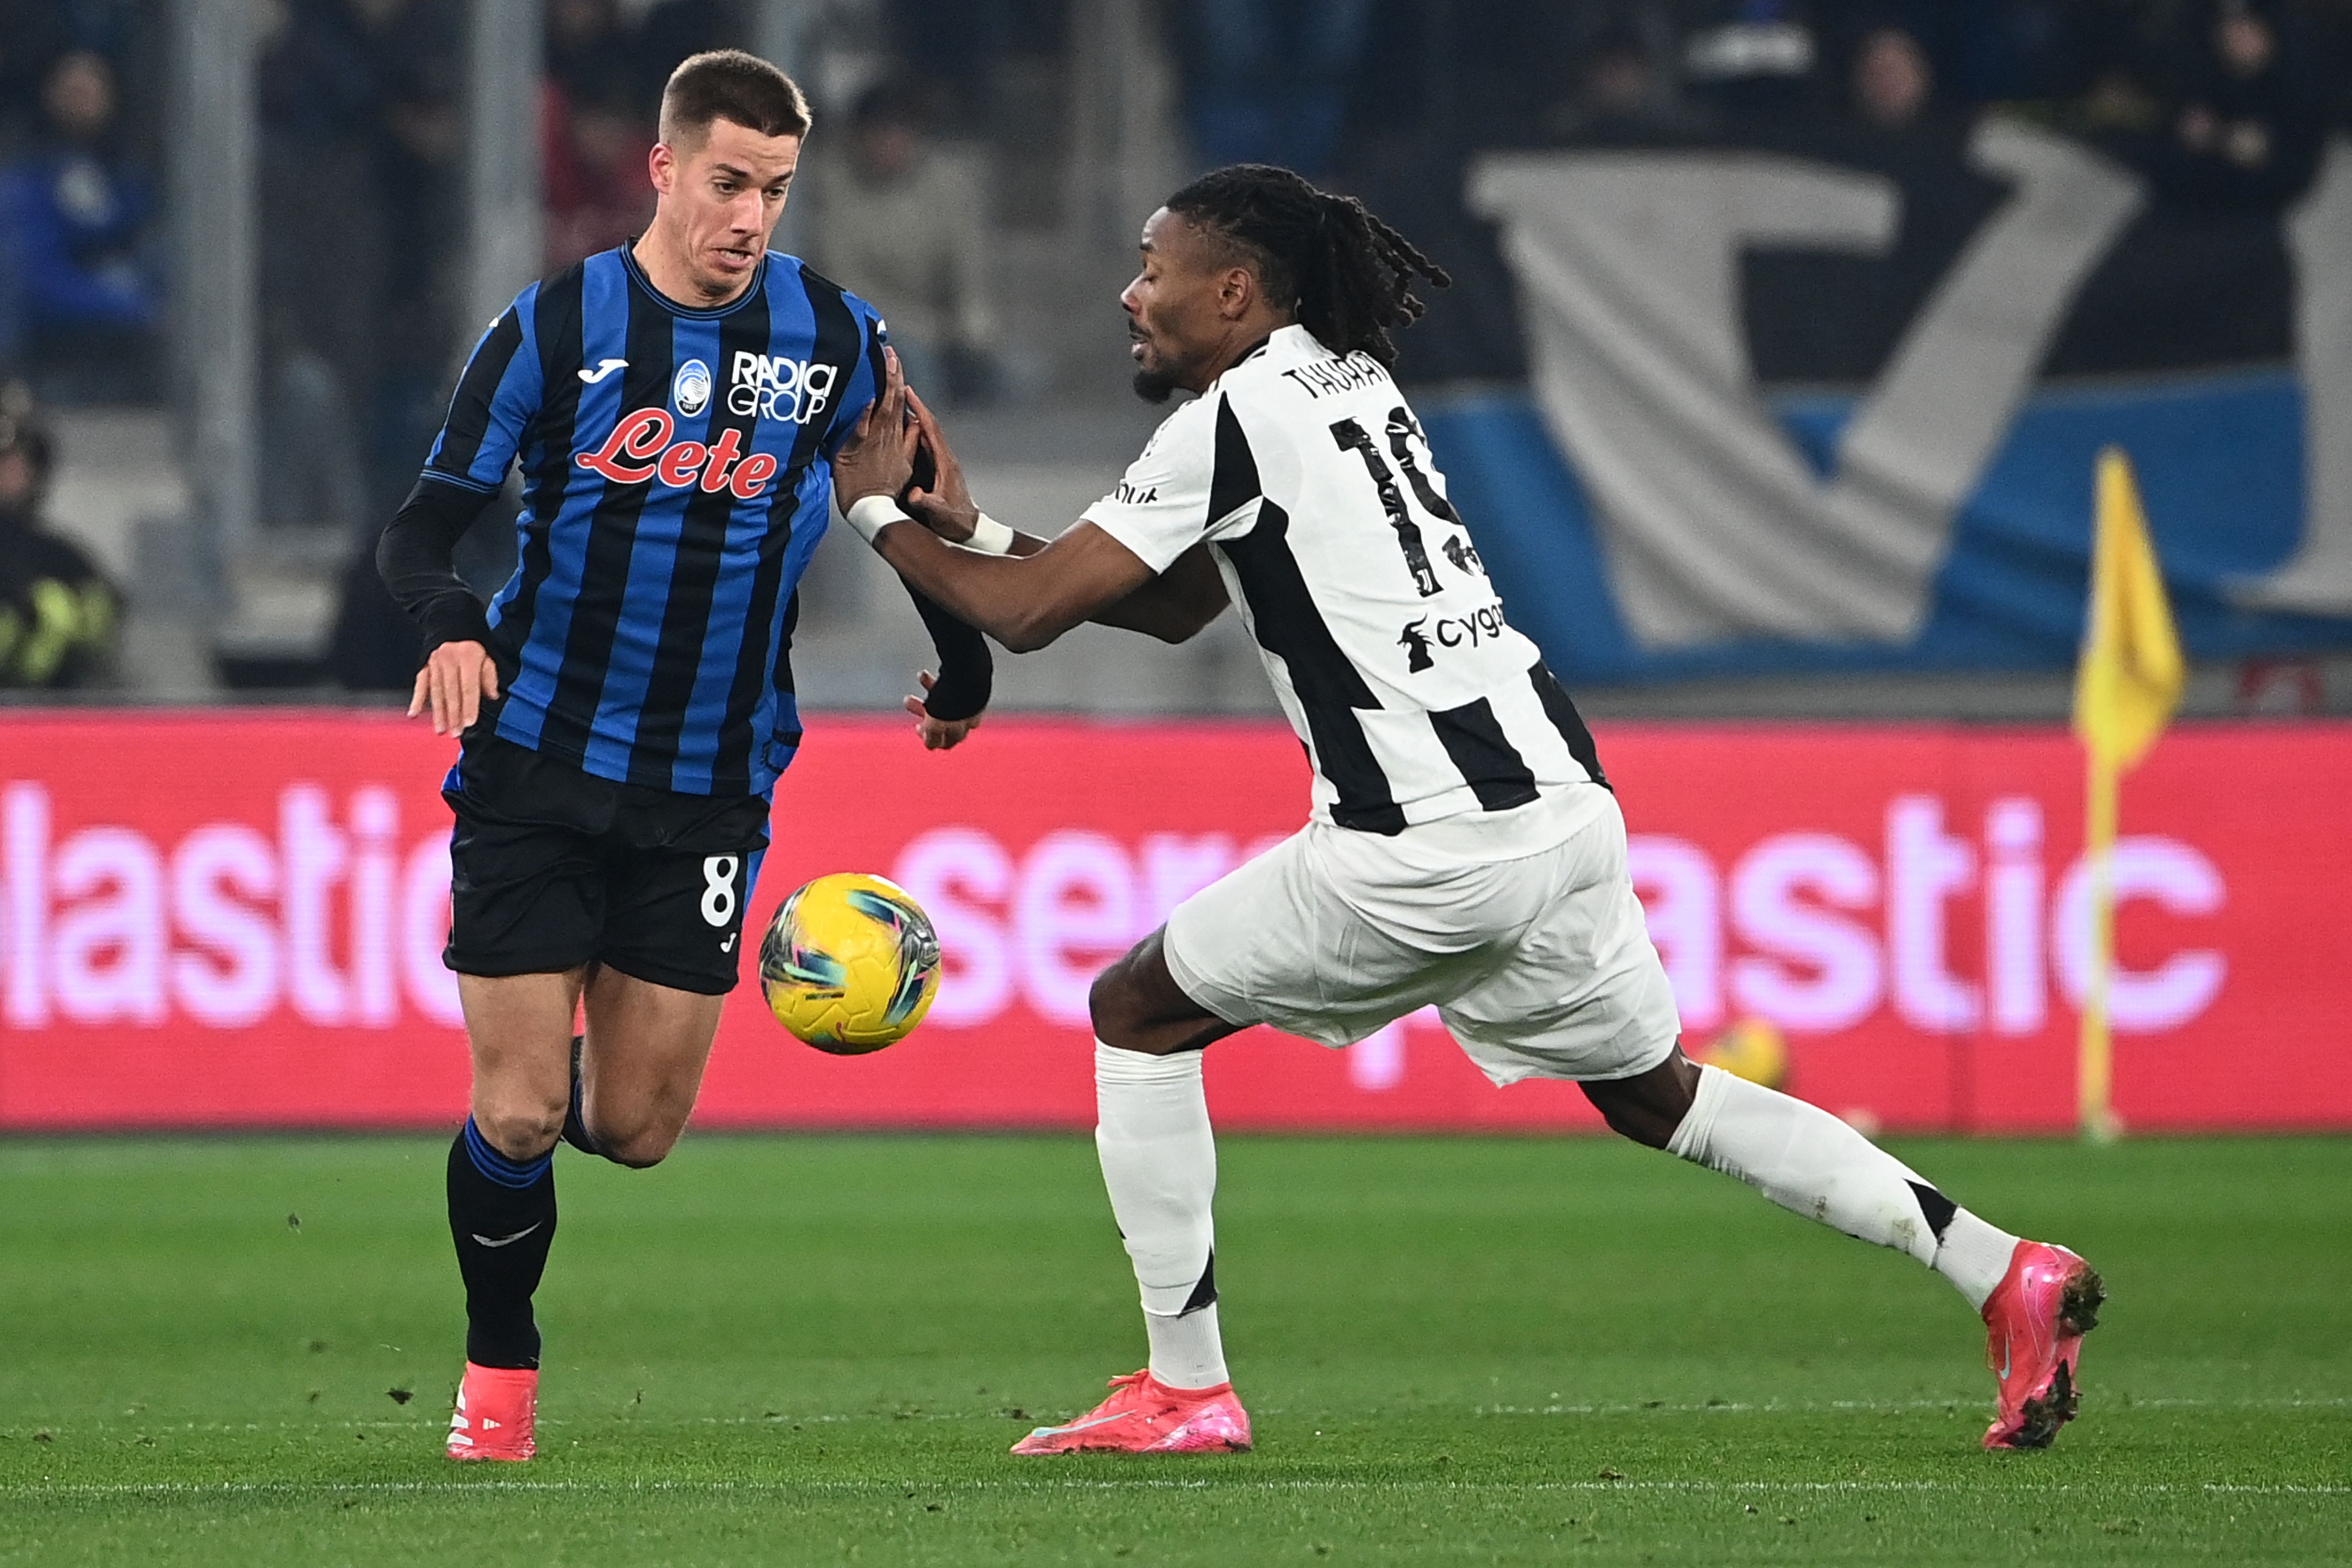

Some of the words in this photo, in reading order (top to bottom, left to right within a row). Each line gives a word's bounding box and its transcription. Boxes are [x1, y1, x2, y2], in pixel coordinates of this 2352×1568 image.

[731, 350, 838, 398] RADICI
[728, 384, 826, 425] GROUP
[576, 408, 777, 499] Lete
[701, 856, 738, 927] 8
